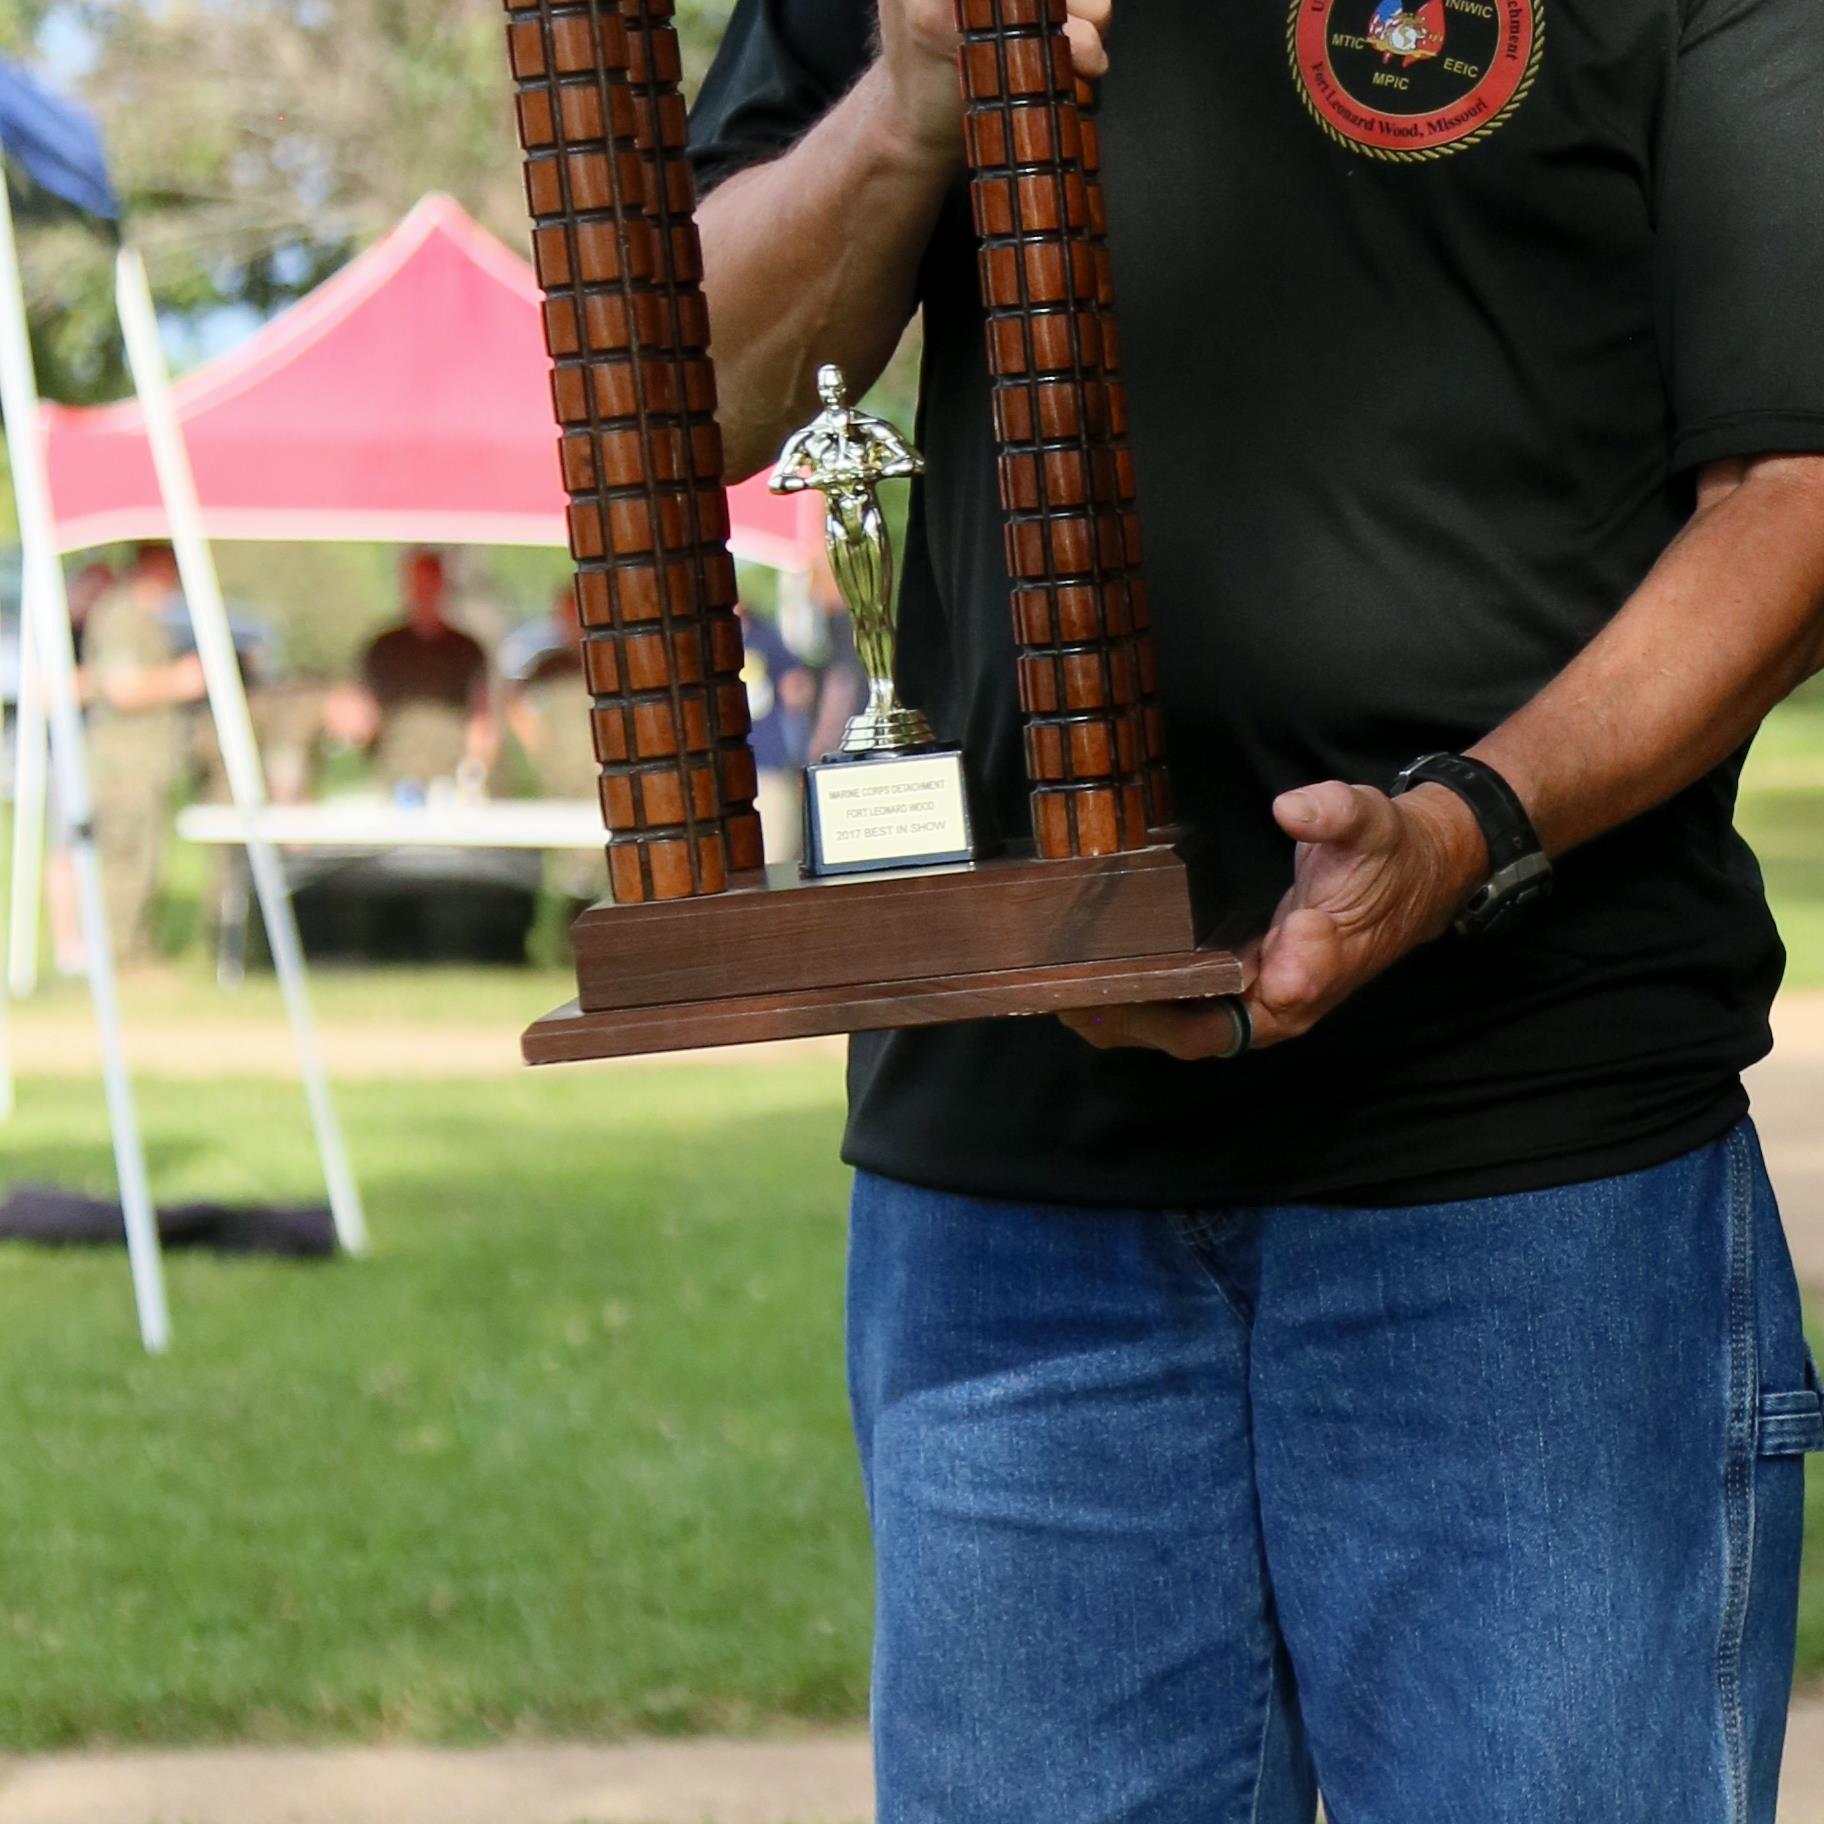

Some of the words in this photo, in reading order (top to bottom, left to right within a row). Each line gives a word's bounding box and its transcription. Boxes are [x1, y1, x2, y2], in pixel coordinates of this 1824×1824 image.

[1331, 33, 1366, 50] MTIC
[1443, 57, 1479, 78] EEIC
[1372, 71, 1410, 90] MPIC
[1325, 89, 1375, 131] Leonard
[1378, 120, 1424, 138] Wood,
[1427, 97, 1488, 135] Missouri
[828, 788, 860, 800] MARINE
[862, 785, 890, 797] CORPS
[891, 779, 945, 794] DETACHMENT
[846, 807, 867, 818] FORT
[869, 803, 907, 816] LEONARD
[909, 801, 935, 812] WOOD
[836, 829, 861, 841] 2017
[863, 825, 893, 838] BEST
[896, 824, 908, 834] IN
[910, 820, 947, 834] SHOW
